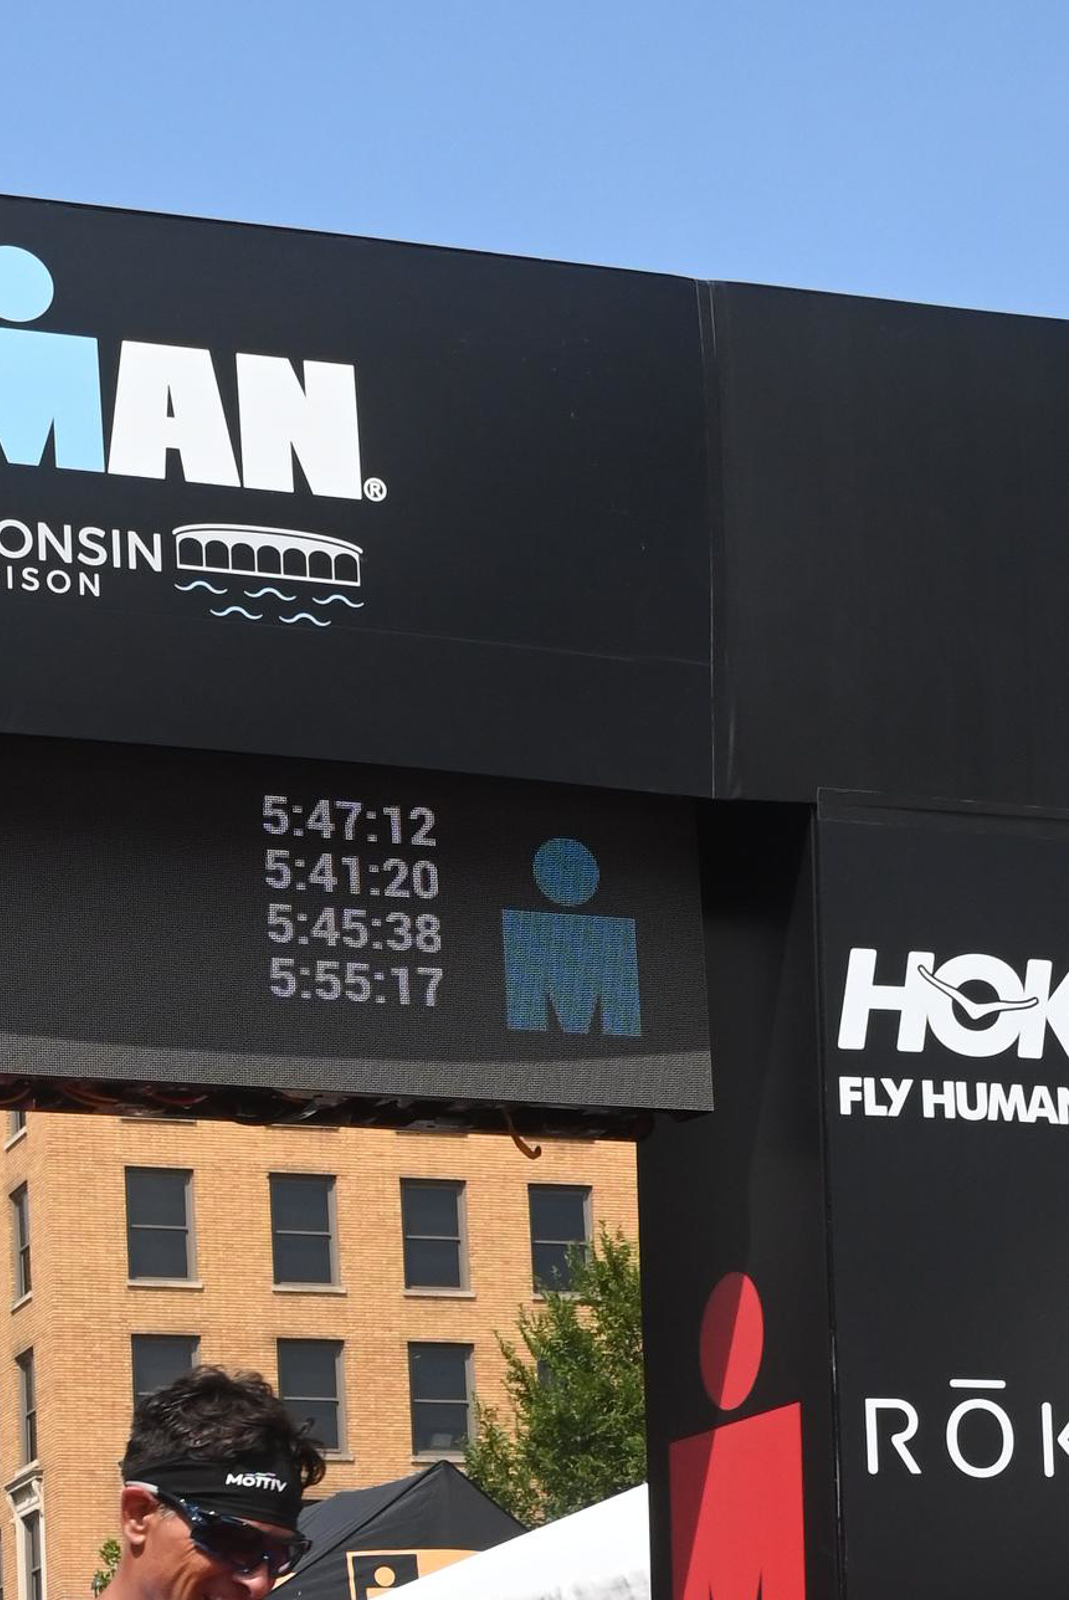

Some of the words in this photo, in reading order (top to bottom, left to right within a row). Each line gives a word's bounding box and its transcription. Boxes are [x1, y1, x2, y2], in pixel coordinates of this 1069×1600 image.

[262, 795, 437, 847] 5:47:12
[264, 849, 439, 900] 5:41:20
[267, 903, 442, 954] 5:45:38
[269, 957, 443, 1007] 5:55:17
[839, 1077, 914, 1117] FLY
